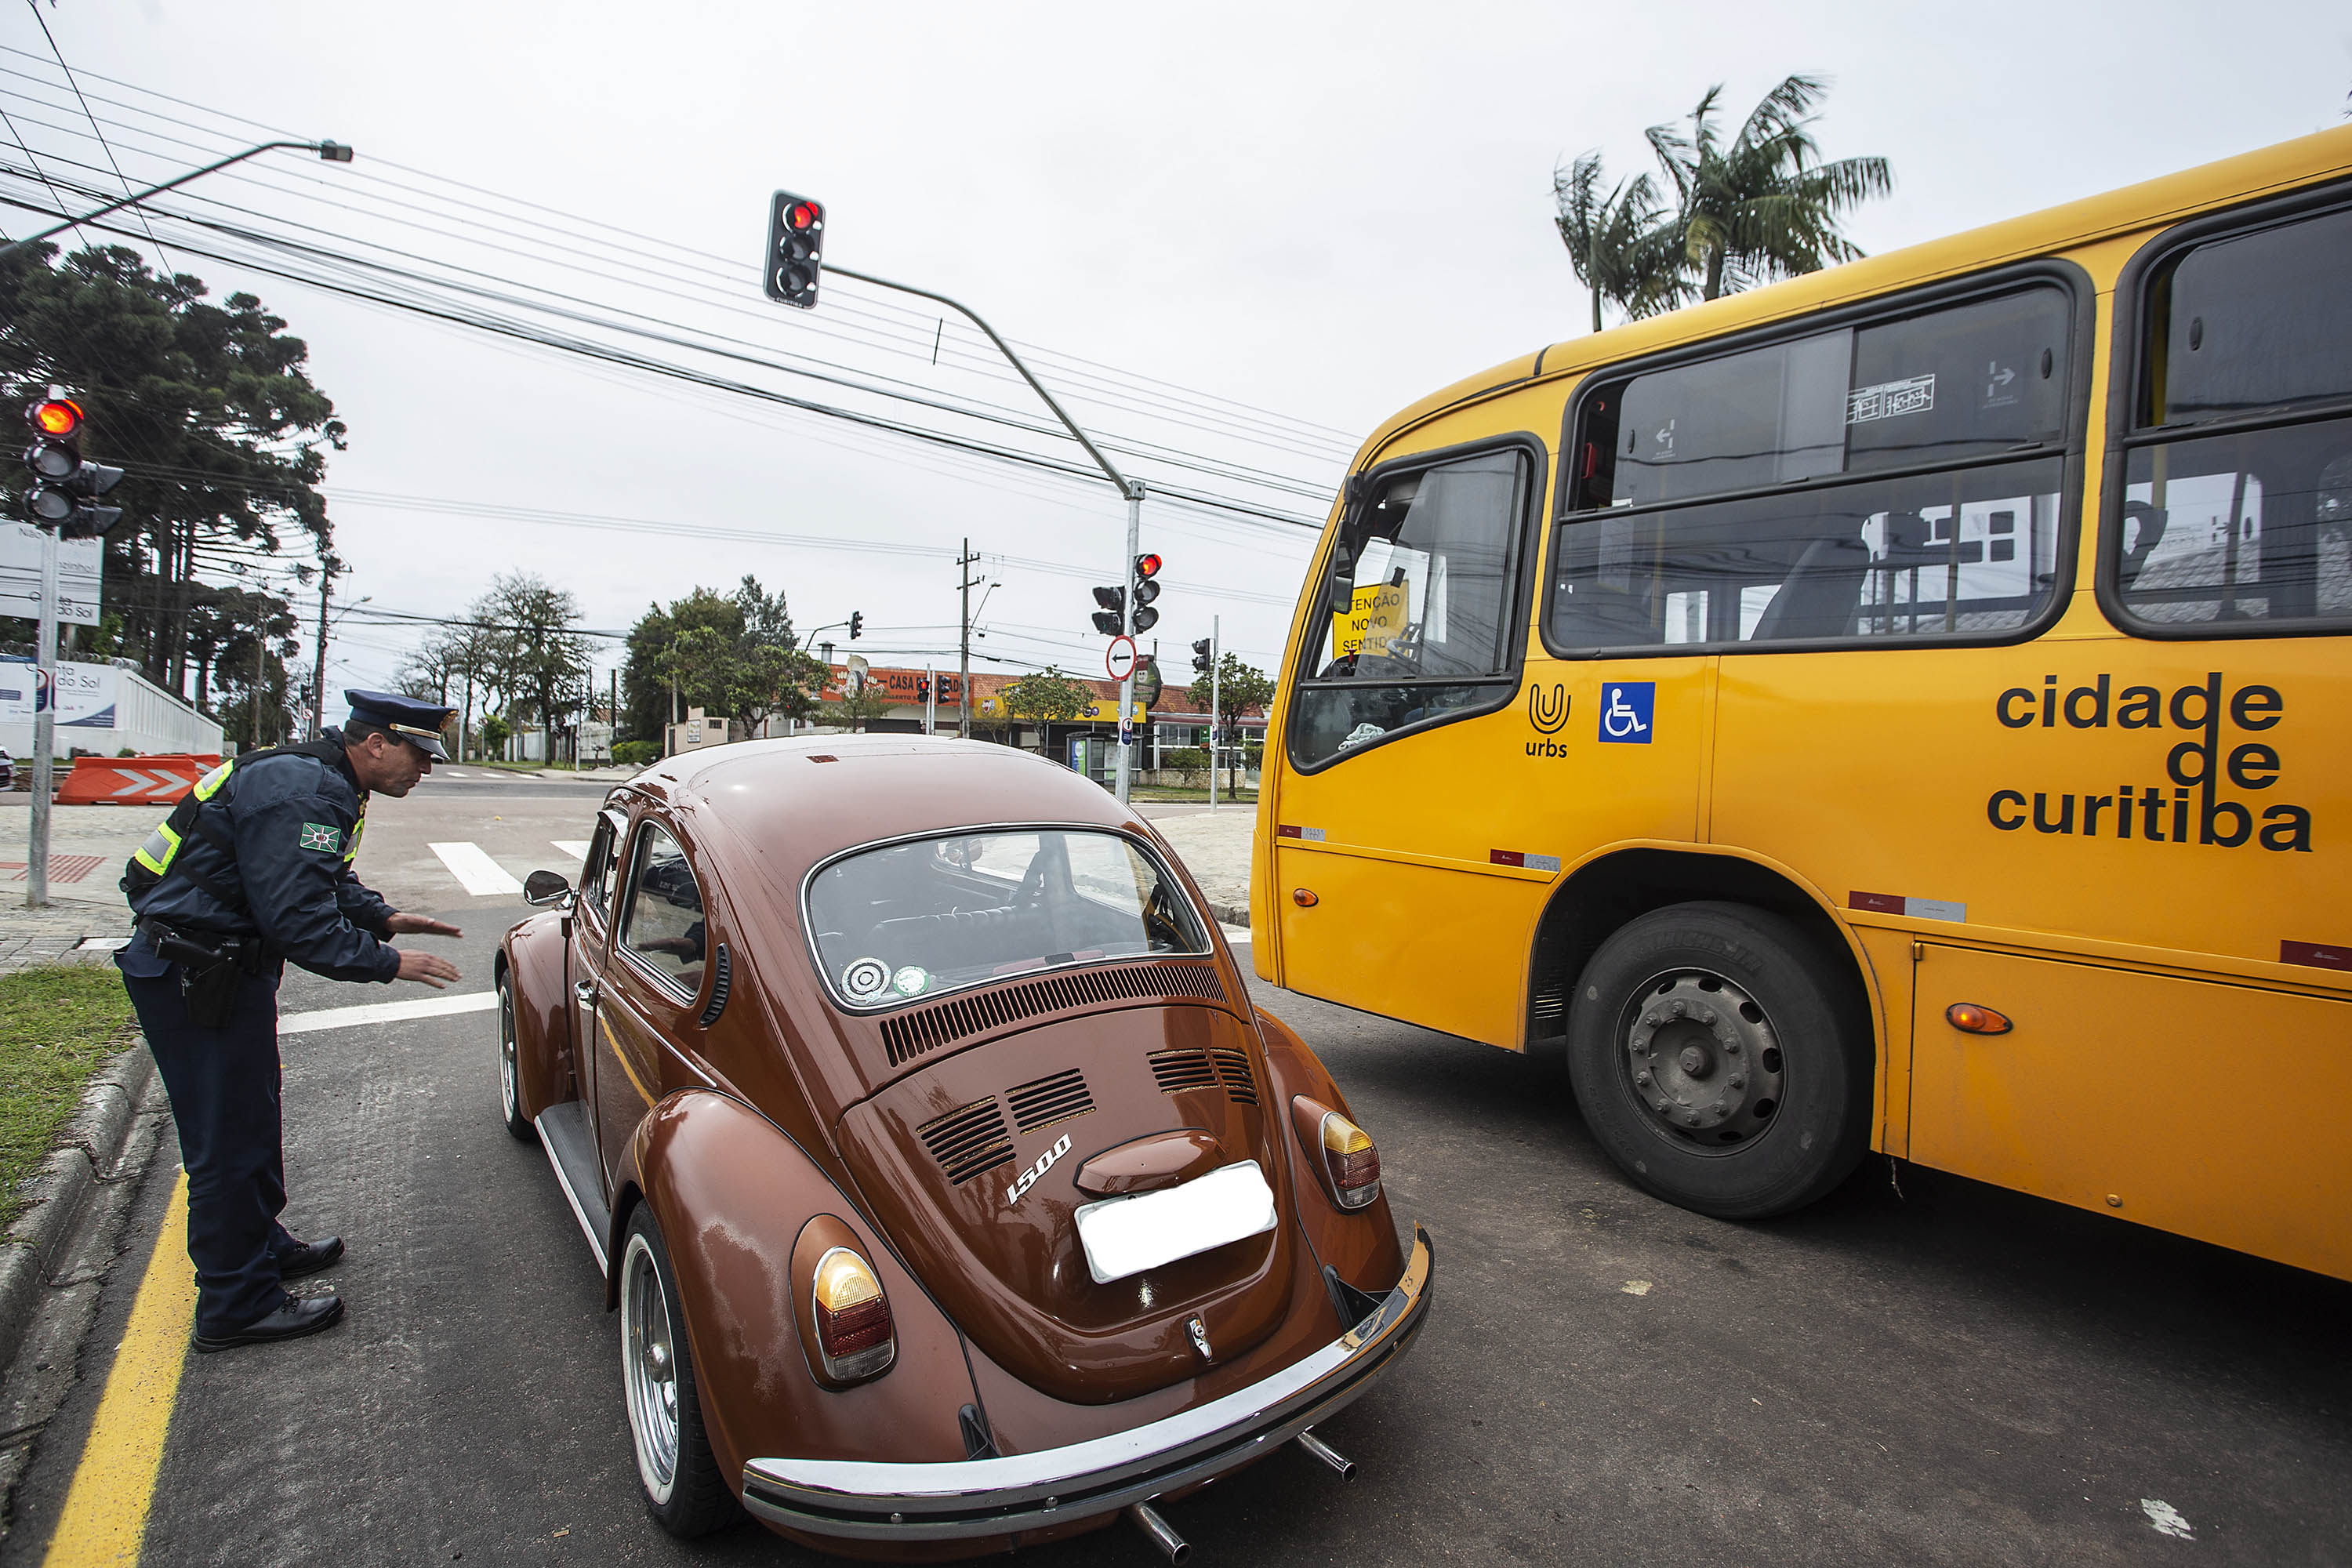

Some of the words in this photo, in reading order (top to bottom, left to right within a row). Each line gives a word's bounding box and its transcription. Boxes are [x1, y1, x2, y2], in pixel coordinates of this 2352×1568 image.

[1352, 615, 1387, 632] NOVO
[1343, 636, 1396, 652] SENTID
[80, 675, 100, 688] Sol
[889, 675, 913, 690] CASA
[1996, 672, 2284, 732] cidade
[1526, 738, 1568, 758] urbs
[2166, 741, 2281, 790] de
[1987, 784, 2314, 853] curitiba
[1007, 1133, 1073, 1205] 1500
